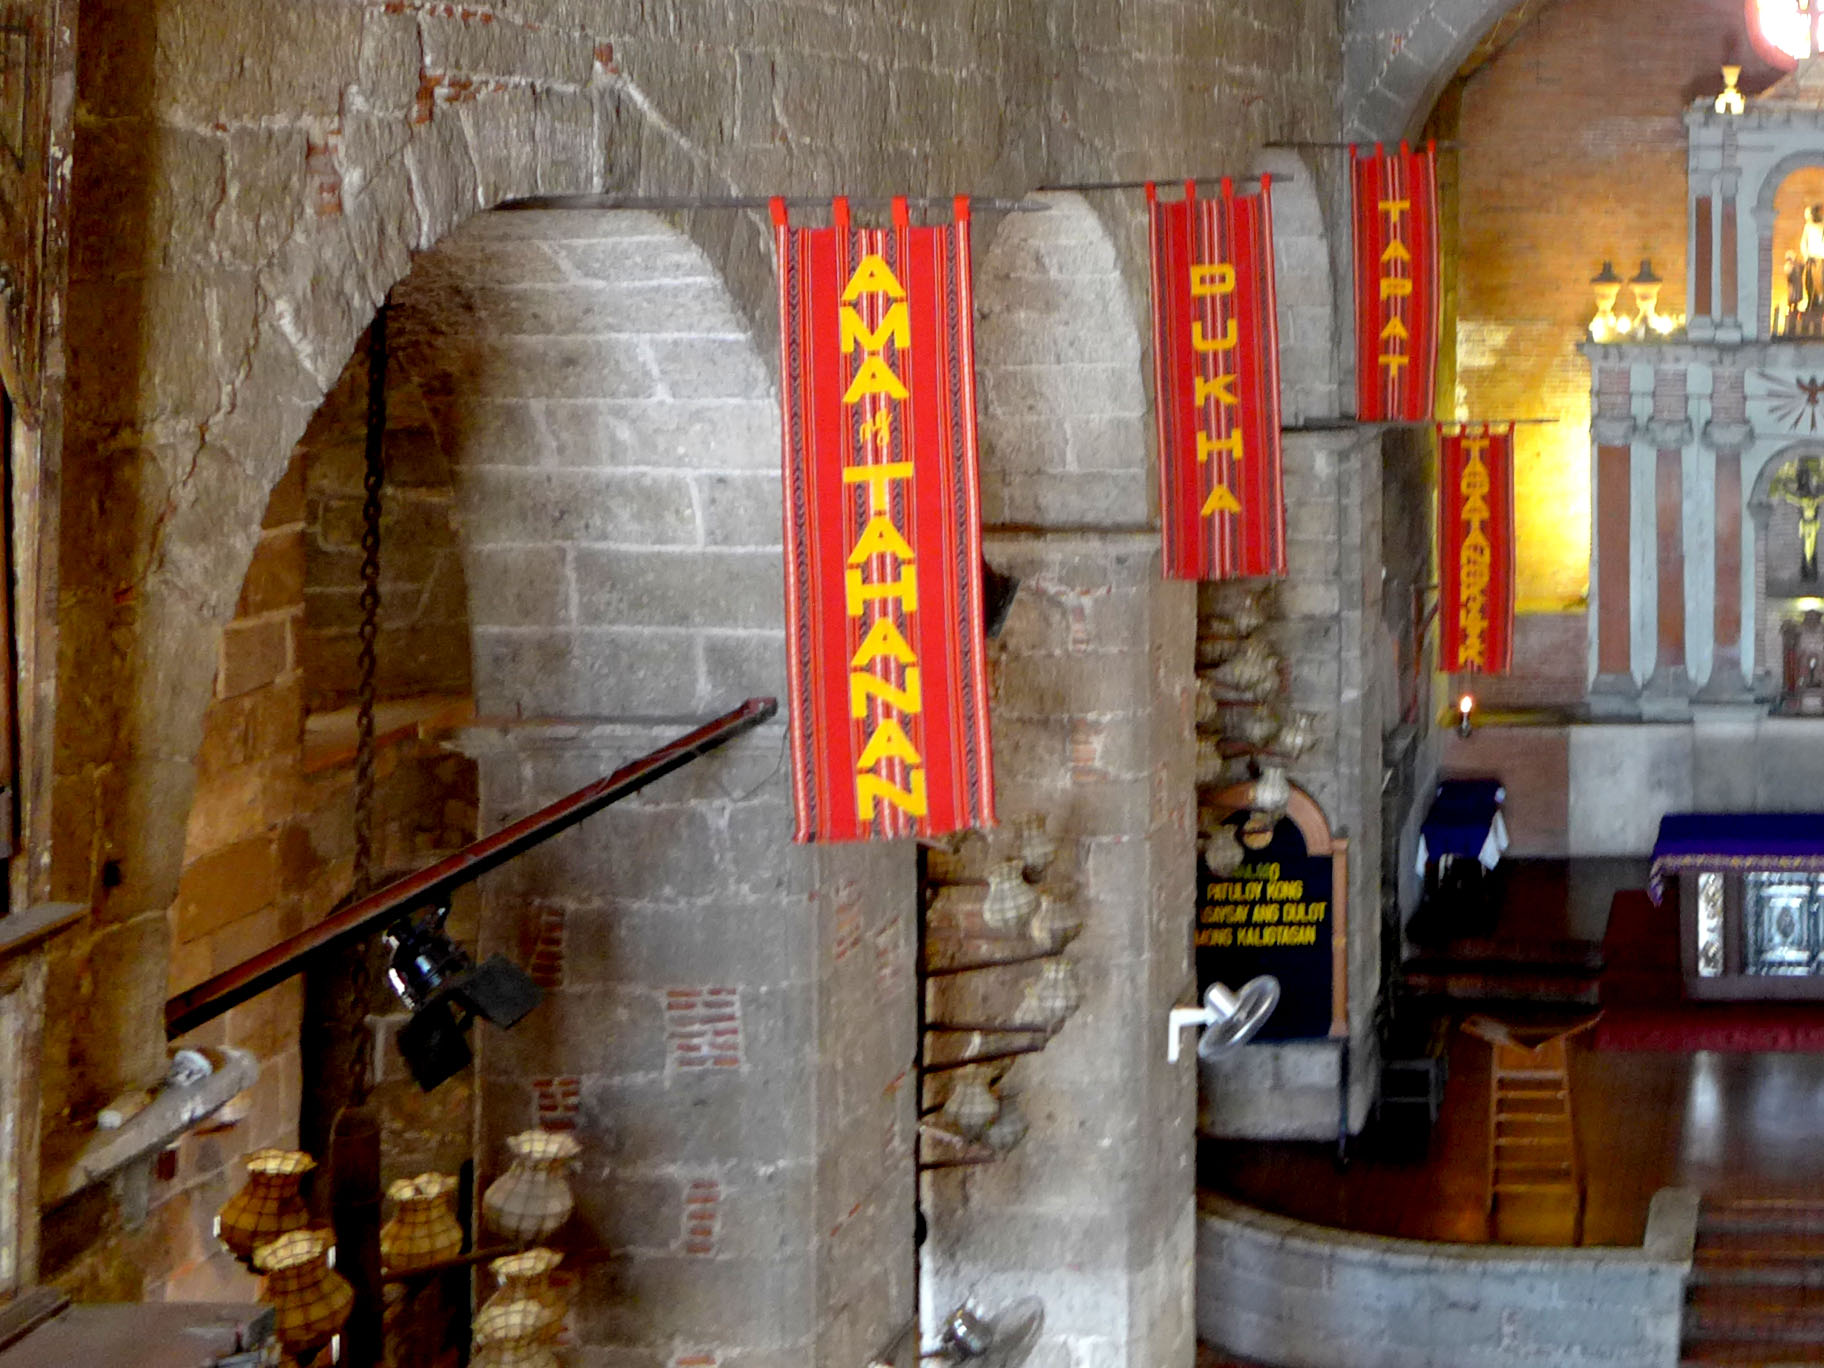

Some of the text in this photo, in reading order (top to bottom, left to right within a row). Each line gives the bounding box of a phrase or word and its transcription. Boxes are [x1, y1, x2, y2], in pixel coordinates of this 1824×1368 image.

[839, 254, 910, 402] AMA
[1190, 263, 1244, 517] DUKHA
[1378, 199, 1413, 378] TAPAT
[843, 461, 928, 821] TAHANAN
